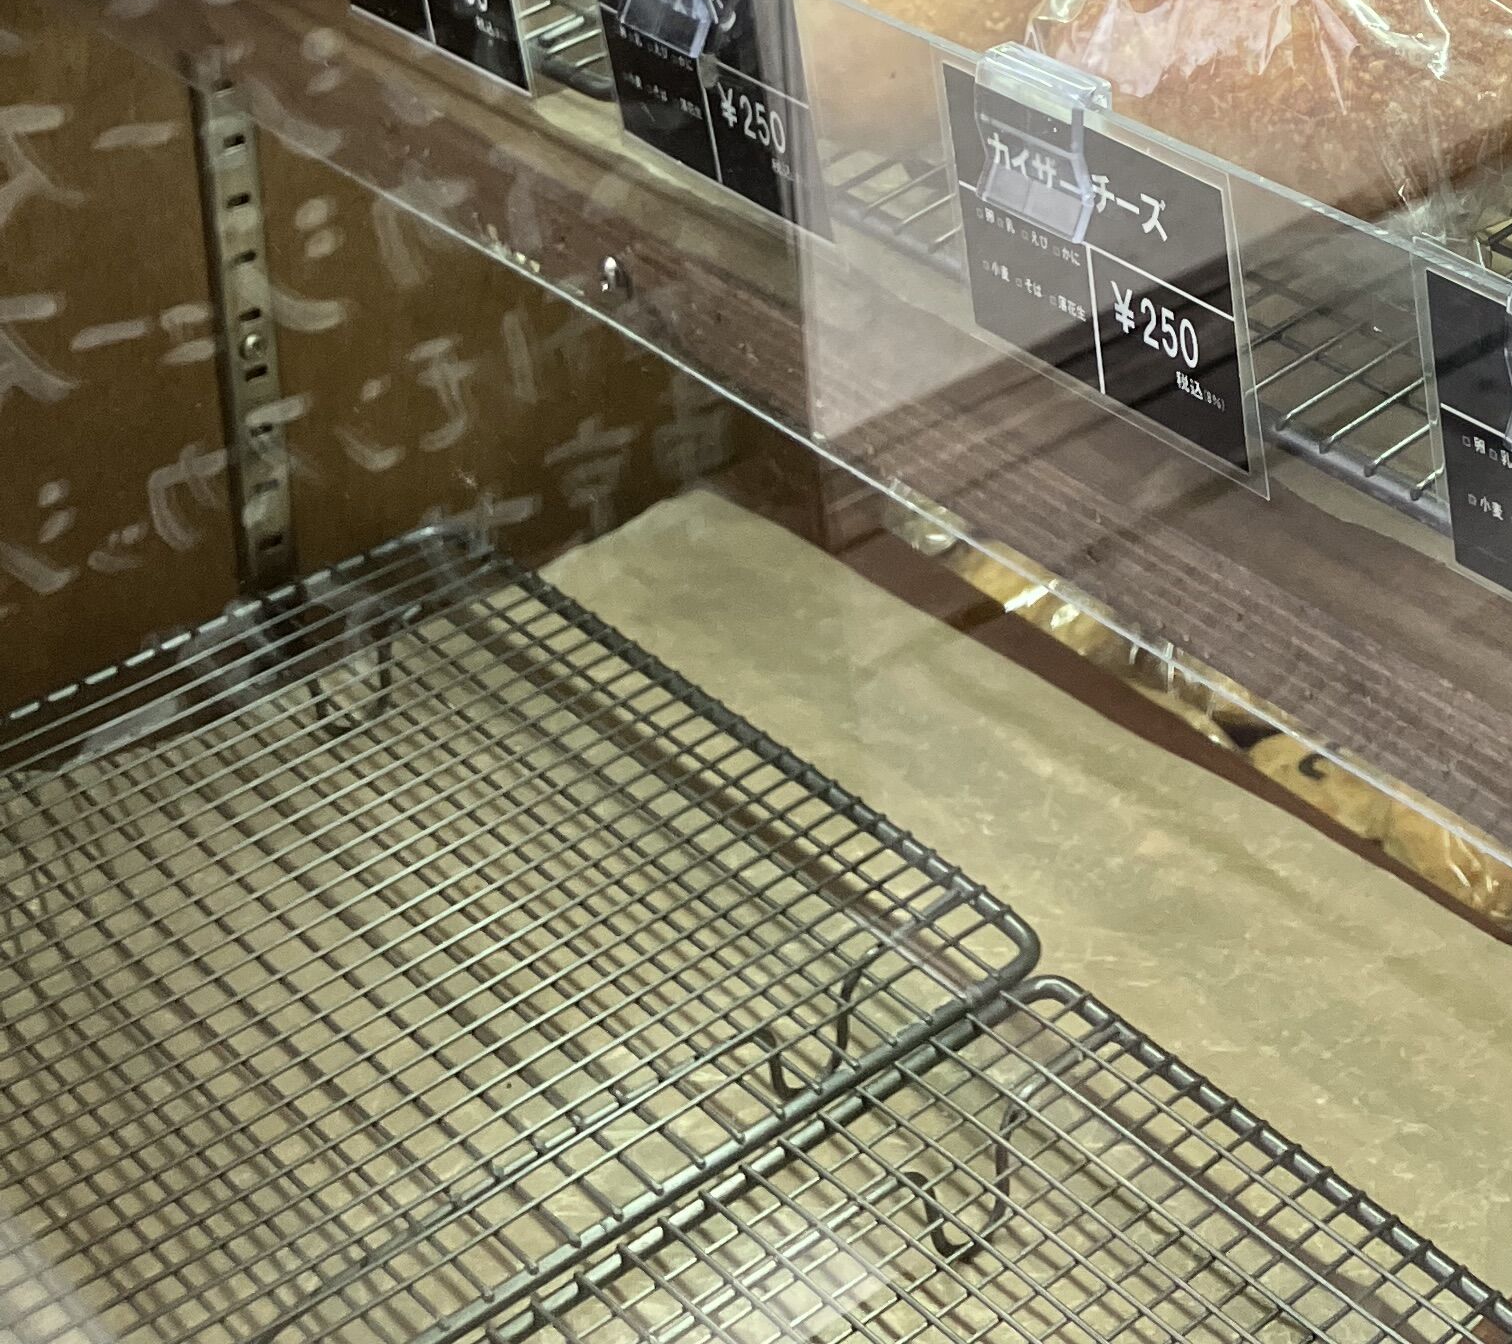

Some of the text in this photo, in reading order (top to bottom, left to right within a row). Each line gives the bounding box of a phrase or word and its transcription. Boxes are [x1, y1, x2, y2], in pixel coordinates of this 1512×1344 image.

[718, 82, 785, 153] ¥250
[987, 132, 1167, 242] カイザーチーズ
[1110, 281, 1199, 368] ¥250
